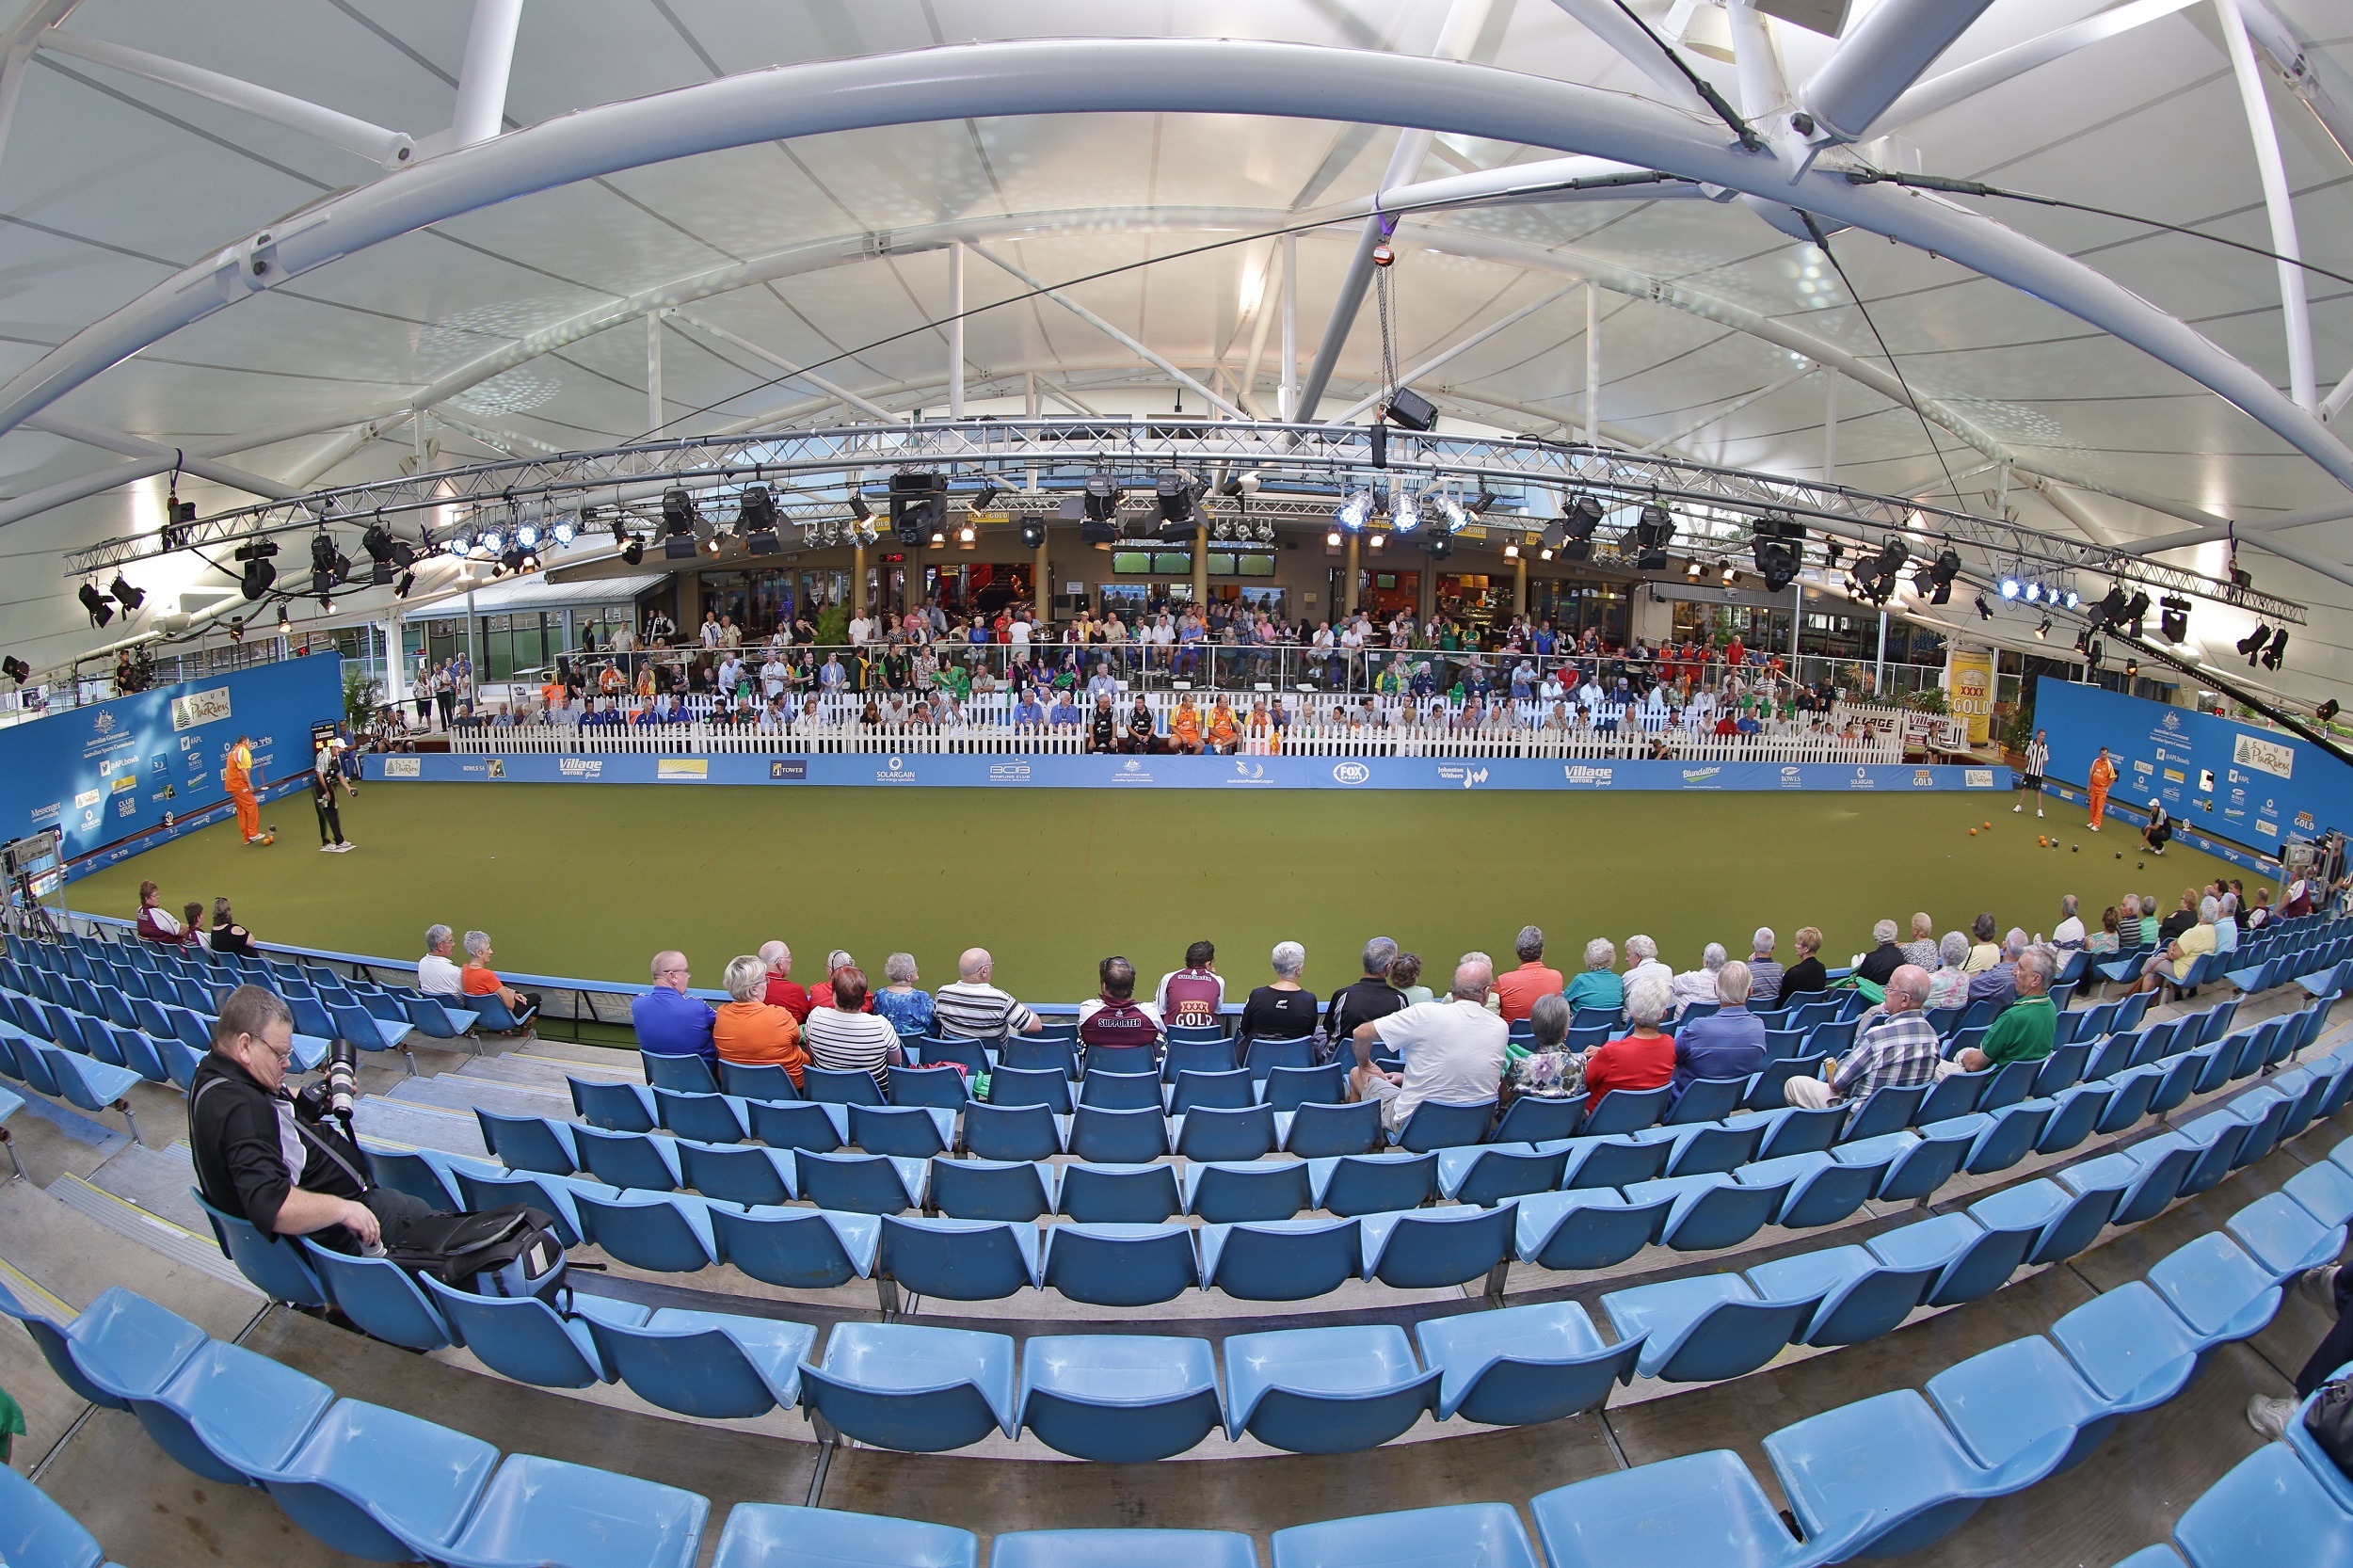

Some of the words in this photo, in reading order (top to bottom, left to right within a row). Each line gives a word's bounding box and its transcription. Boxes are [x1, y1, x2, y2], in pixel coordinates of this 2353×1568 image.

[189, 690, 226, 703] CLUB
[1960, 685, 1985, 696] XXXX
[1953, 697, 1989, 715] GOLD
[1849, 715, 1895, 728] ILLAGE
[2252, 741, 2290, 757] CLUB
[111, 755, 139, 770] @APLbowls
[559, 758, 602, 770] Village
[2166, 754, 2190, 765] @APLbowls
[1340, 766, 1362, 776] FOX
[1564, 765, 1612, 777] Village
[1913, 777, 1933, 786] GOLD
[118, 797, 135, 808] CLUB
[31, 802, 61, 819] Messenger
[120, 808, 136, 818] LEWIS
[2294, 817, 2314, 830] GOLD
[1183, 1002, 1208, 1011] XXXX
[1098, 1017, 1142, 1028] SUPPORTER
[1176, 1013, 1213, 1027] GOLD
